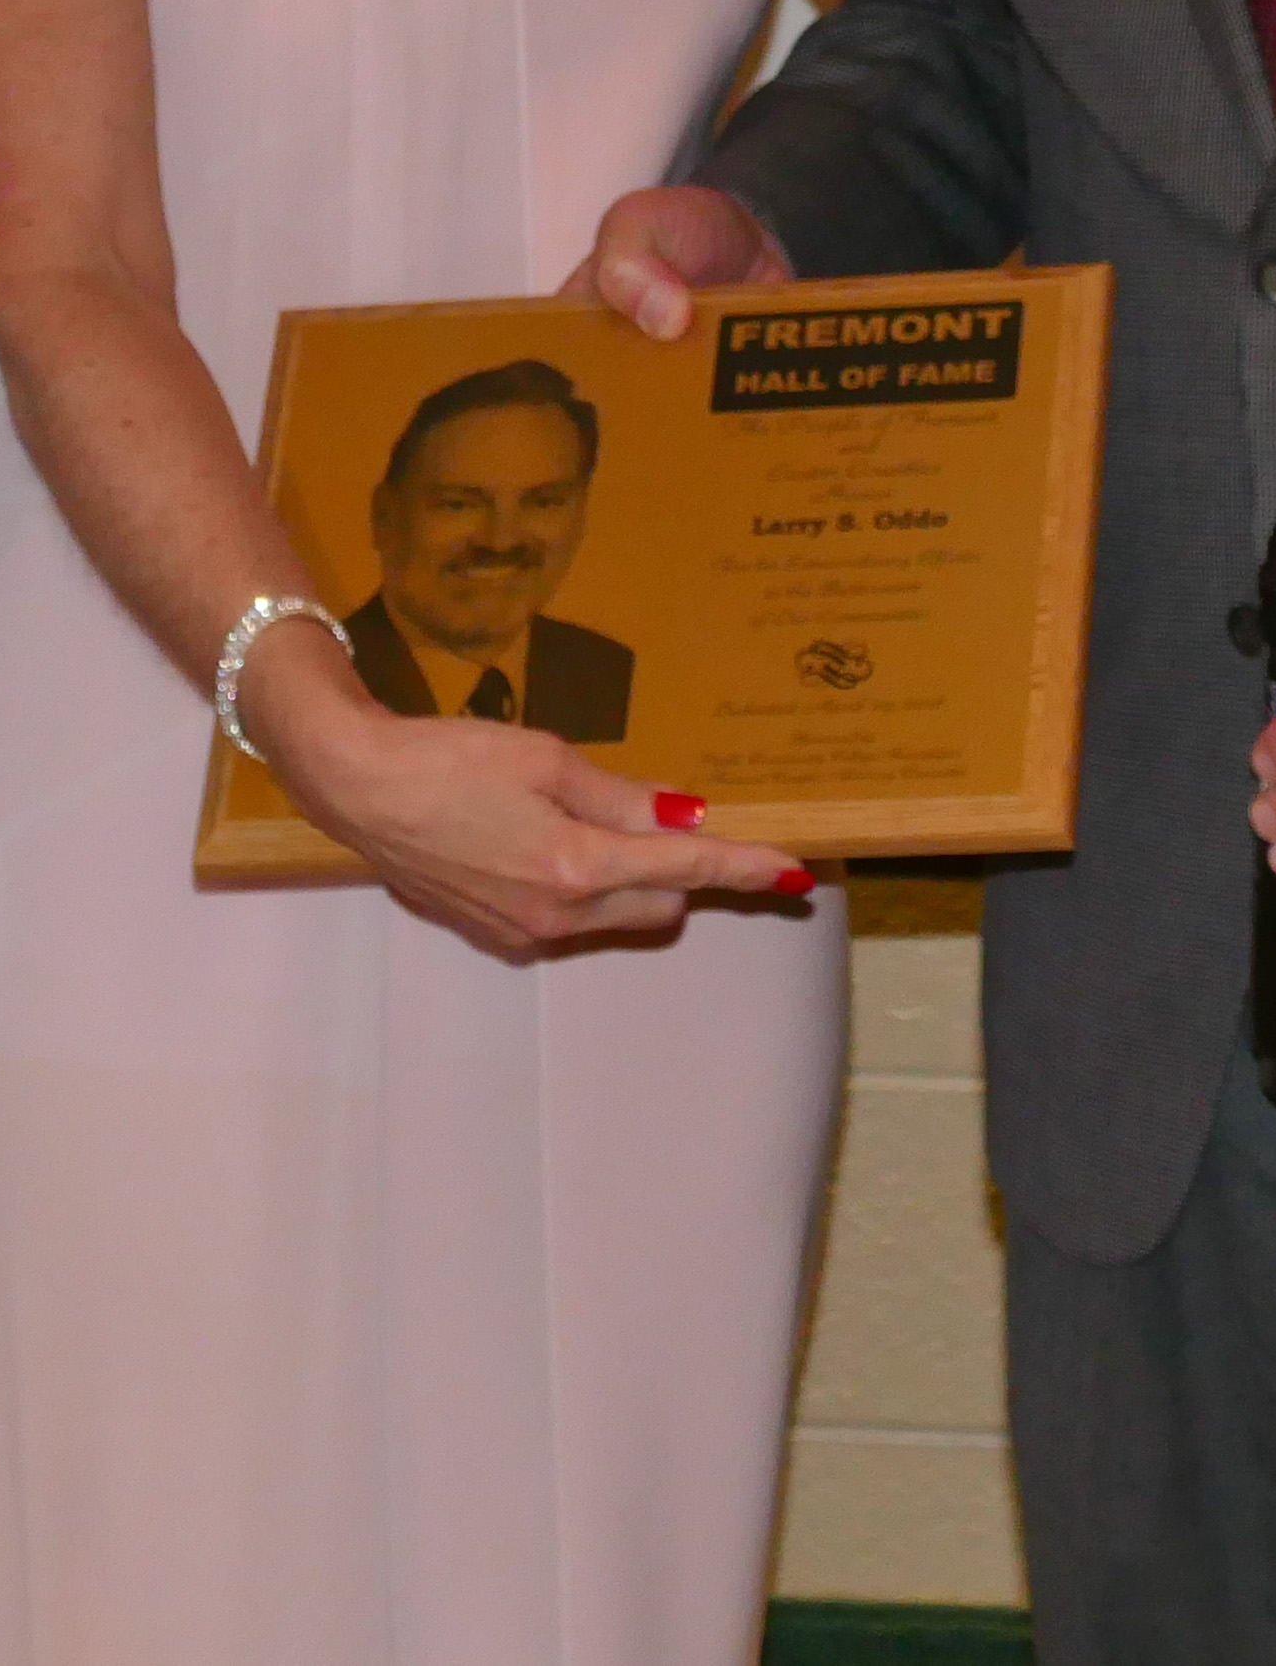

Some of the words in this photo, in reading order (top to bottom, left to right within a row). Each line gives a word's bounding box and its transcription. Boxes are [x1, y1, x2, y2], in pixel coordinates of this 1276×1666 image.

[729, 308, 1013, 352] FREMONT
[733, 367, 828, 395] HALL
[839, 363, 889, 390] OF
[897, 359, 997, 387] FAME
[751, 514, 827, 538] Larry
[873, 507, 950, 531] Oddo
